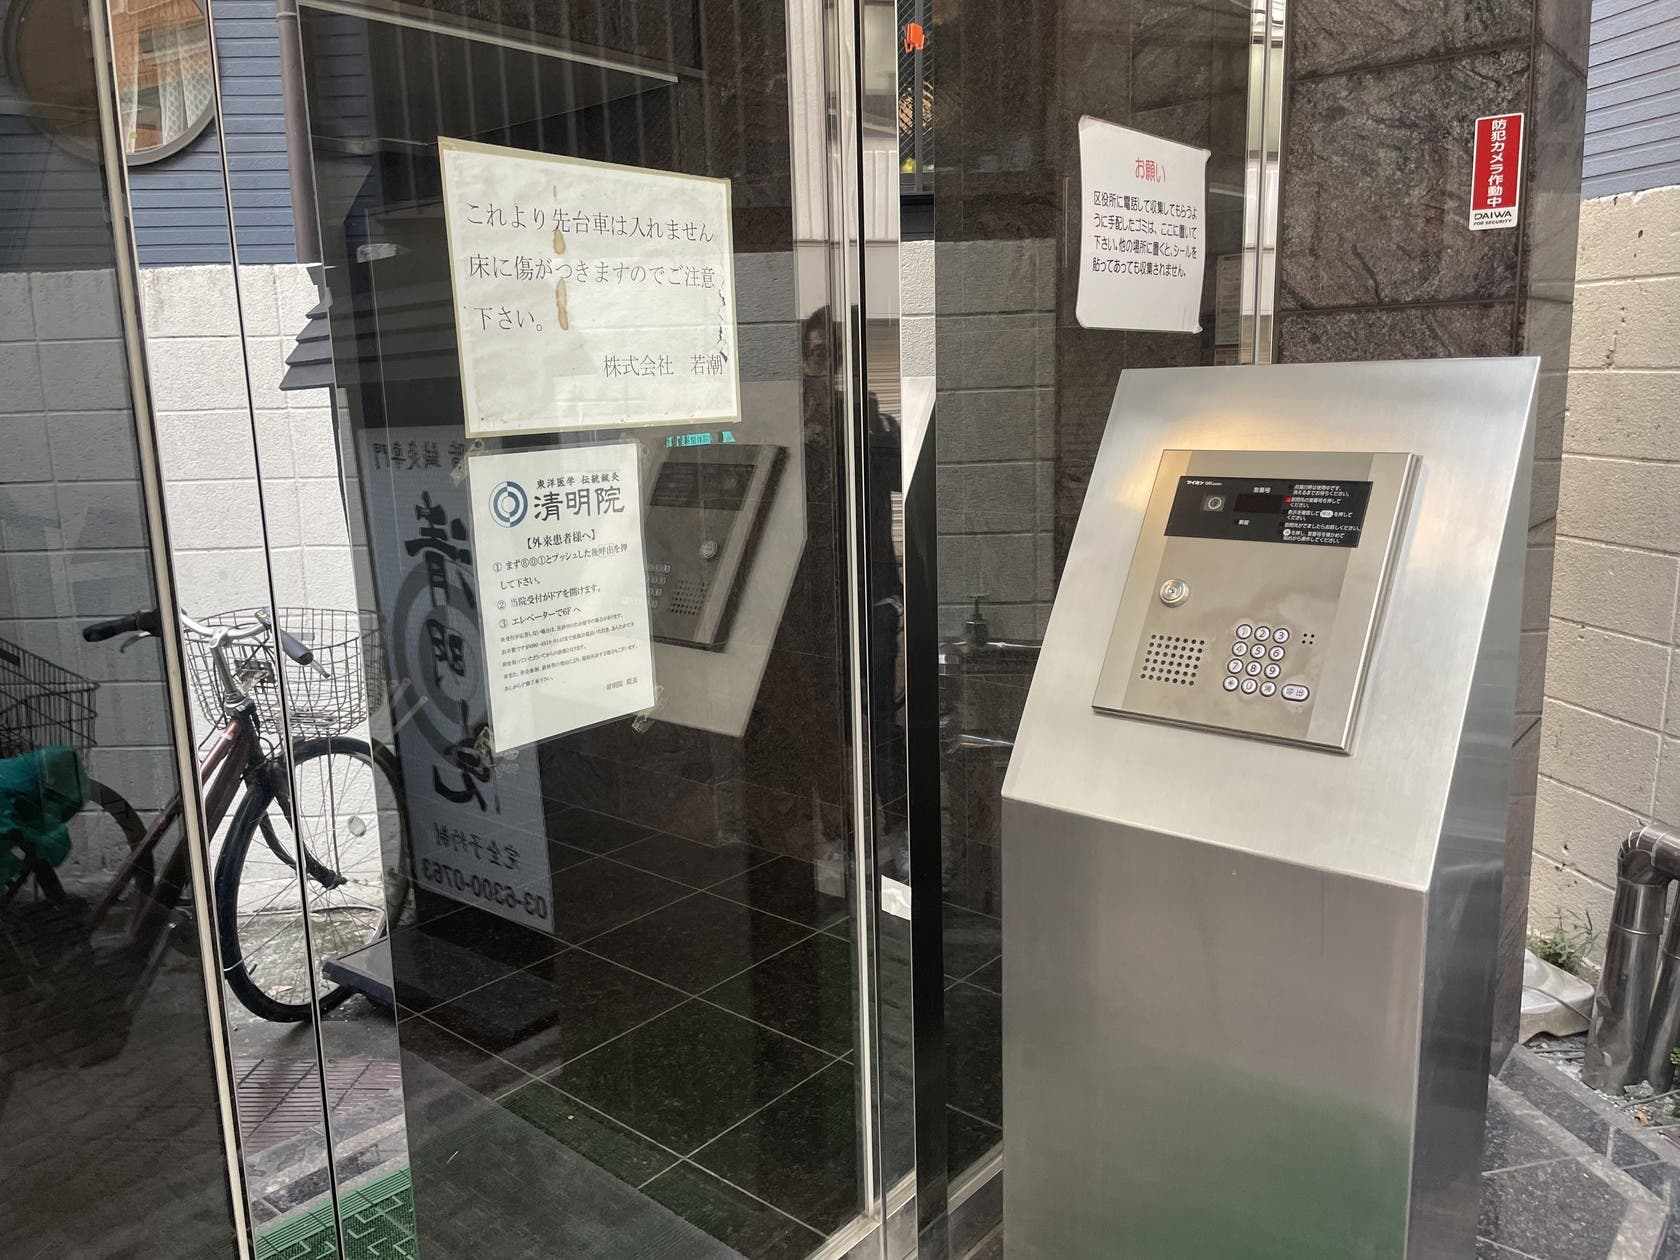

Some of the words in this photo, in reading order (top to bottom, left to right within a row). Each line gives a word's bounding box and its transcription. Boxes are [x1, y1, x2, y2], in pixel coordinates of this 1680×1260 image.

[1135, 157, 1167, 183] お願い
[1487, 119, 1507, 207] 防犯カメラ作動中
[1093, 190, 1198, 220] 区役所に電話して収集してもらうよ
[1474, 210, 1512, 221] DAIWA
[467, 202, 714, 243] これより先台車は入れません
[1093, 214, 1197, 239] うに手配したゴミは、ここに置いて
[469, 254, 716, 289] 床に傷がつきますのでご注意
[1092, 258, 1187, 278] 貼ってあっても収集されません。
[474, 306, 544, 332] 下さい。
[603, 355, 674, 378] 株式会社
[690, 354, 724, 376] 若潮
[537, 476, 575, 490] 東洋医学
[581, 471, 620, 485] 伝統鍼灸
[534, 486, 625, 521] 清明院
[527, 529, 596, 550] 【外来患者様へ】
[500, 576, 541, 591] して下さい。
[510, 584, 601, 608] 当院受付がドアを開けます。
